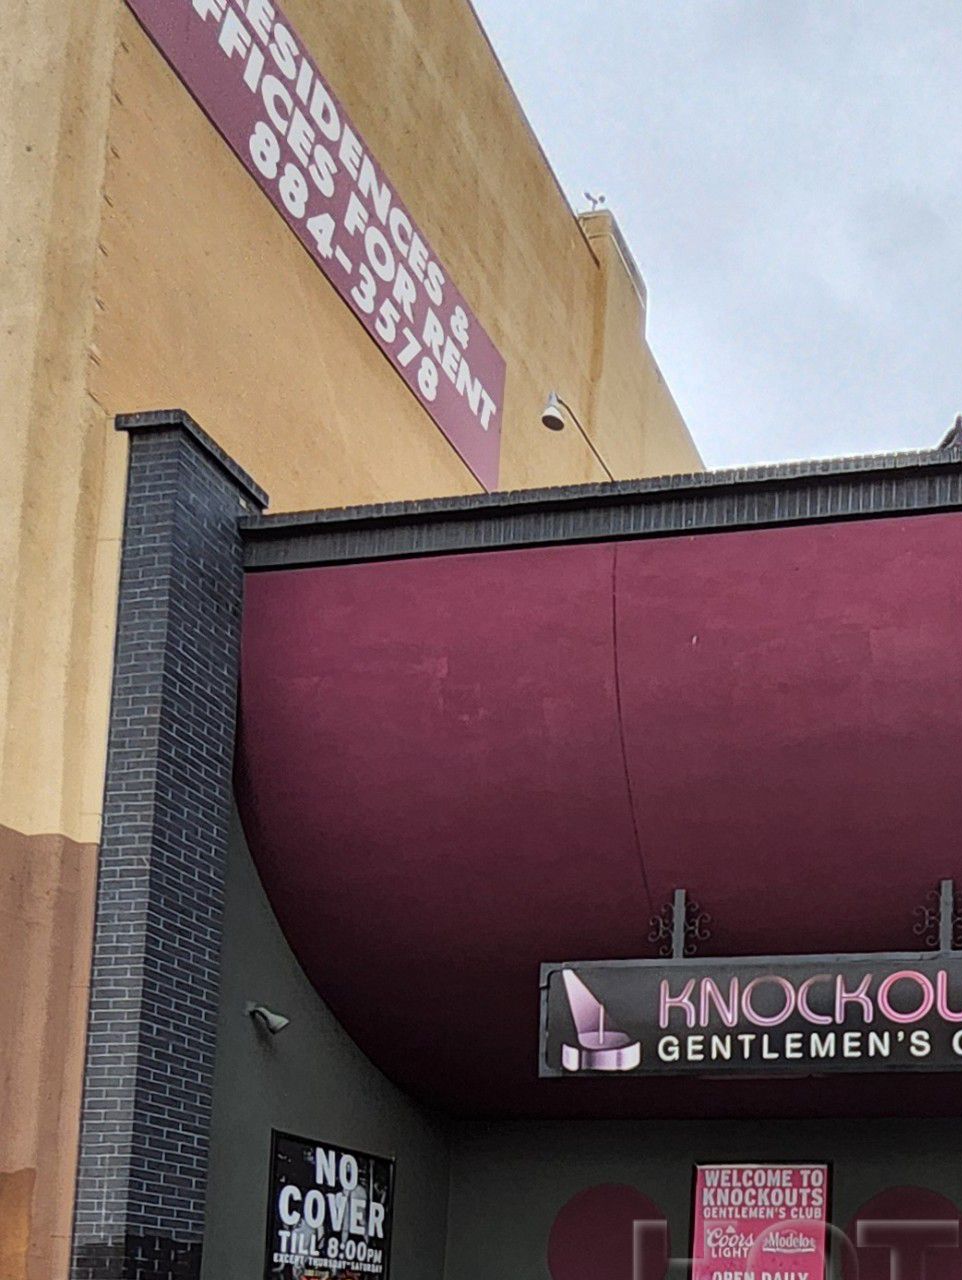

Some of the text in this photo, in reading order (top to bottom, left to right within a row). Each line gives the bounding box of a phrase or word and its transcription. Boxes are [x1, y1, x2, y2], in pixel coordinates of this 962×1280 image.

[235, 0, 469, 349] ESIDENCES &
[249, 121, 439, 402] 884-3578
[344, 191, 417, 323] FOR
[423, 307, 497, 432] RENT
[658, 1031, 931, 1062] GENTLEMEN'S
[315, 1147, 358, 1190] NO
[704, 1169, 823, 1187] WELCOME TO
[278, 1185, 385, 1238] COVER
[703, 1188, 823, 1206] KNOCKOUTS
[703, 1207, 822, 1219] GENTLEMEN'S CLUB
[278, 1230, 382, 1264] TILL 8:00PM
[706, 1228, 754, 1248] Coors
[711, 1247, 750, 1258] LIGHT
[766, 1231, 812, 1248] Modelo
